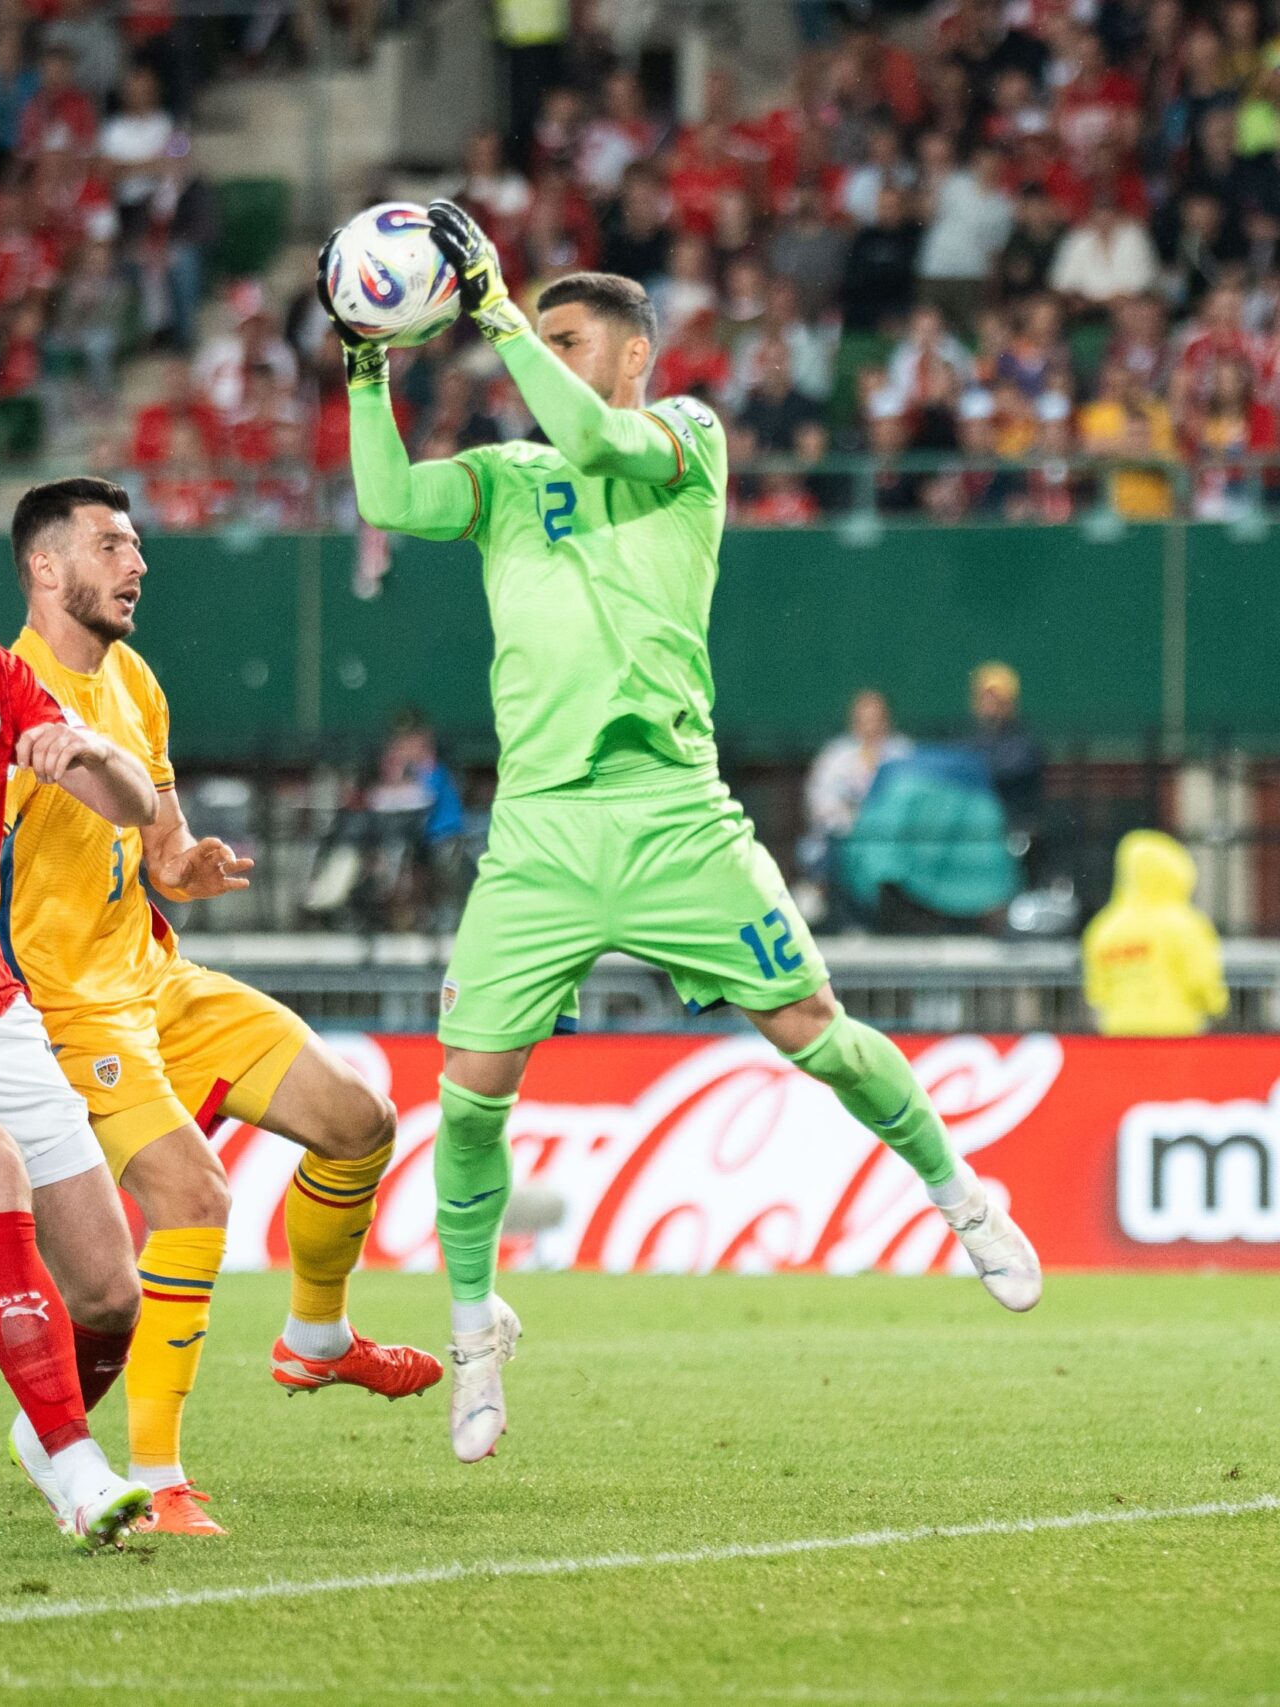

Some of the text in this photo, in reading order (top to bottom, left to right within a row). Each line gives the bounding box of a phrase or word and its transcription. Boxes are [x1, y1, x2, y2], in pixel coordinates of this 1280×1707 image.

[535, 481, 577, 543] 2
[739, 907, 804, 980] 12
[1151, 1134, 1269, 1210] m
